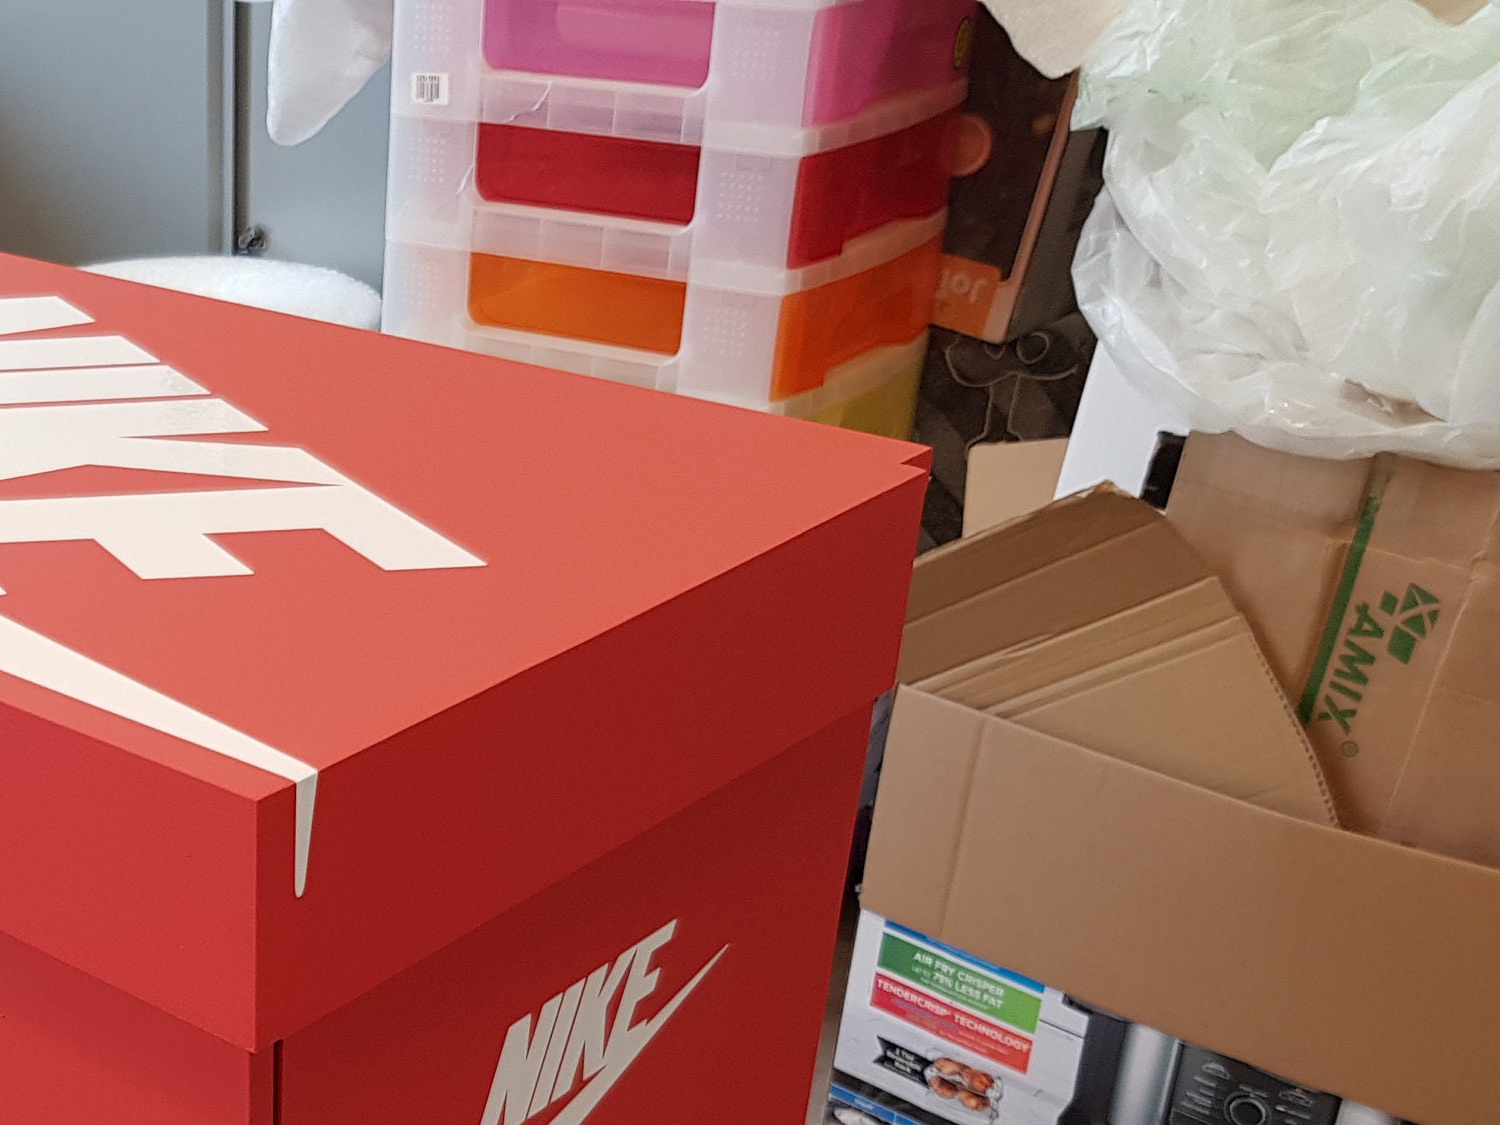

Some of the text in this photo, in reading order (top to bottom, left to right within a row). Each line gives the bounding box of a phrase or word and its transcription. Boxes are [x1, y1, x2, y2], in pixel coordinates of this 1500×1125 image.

[1317, 603, 1384, 735] AMIX
[913, 952, 933, 967] AIR
[934, 958, 955, 976] FRY
[957, 967, 1005, 997] CRISPER
[955, 980, 981, 1001] LESS
[982, 994, 1003, 1009] FAT
[953, 1013, 1031, 1053] TECHNOLOGY
